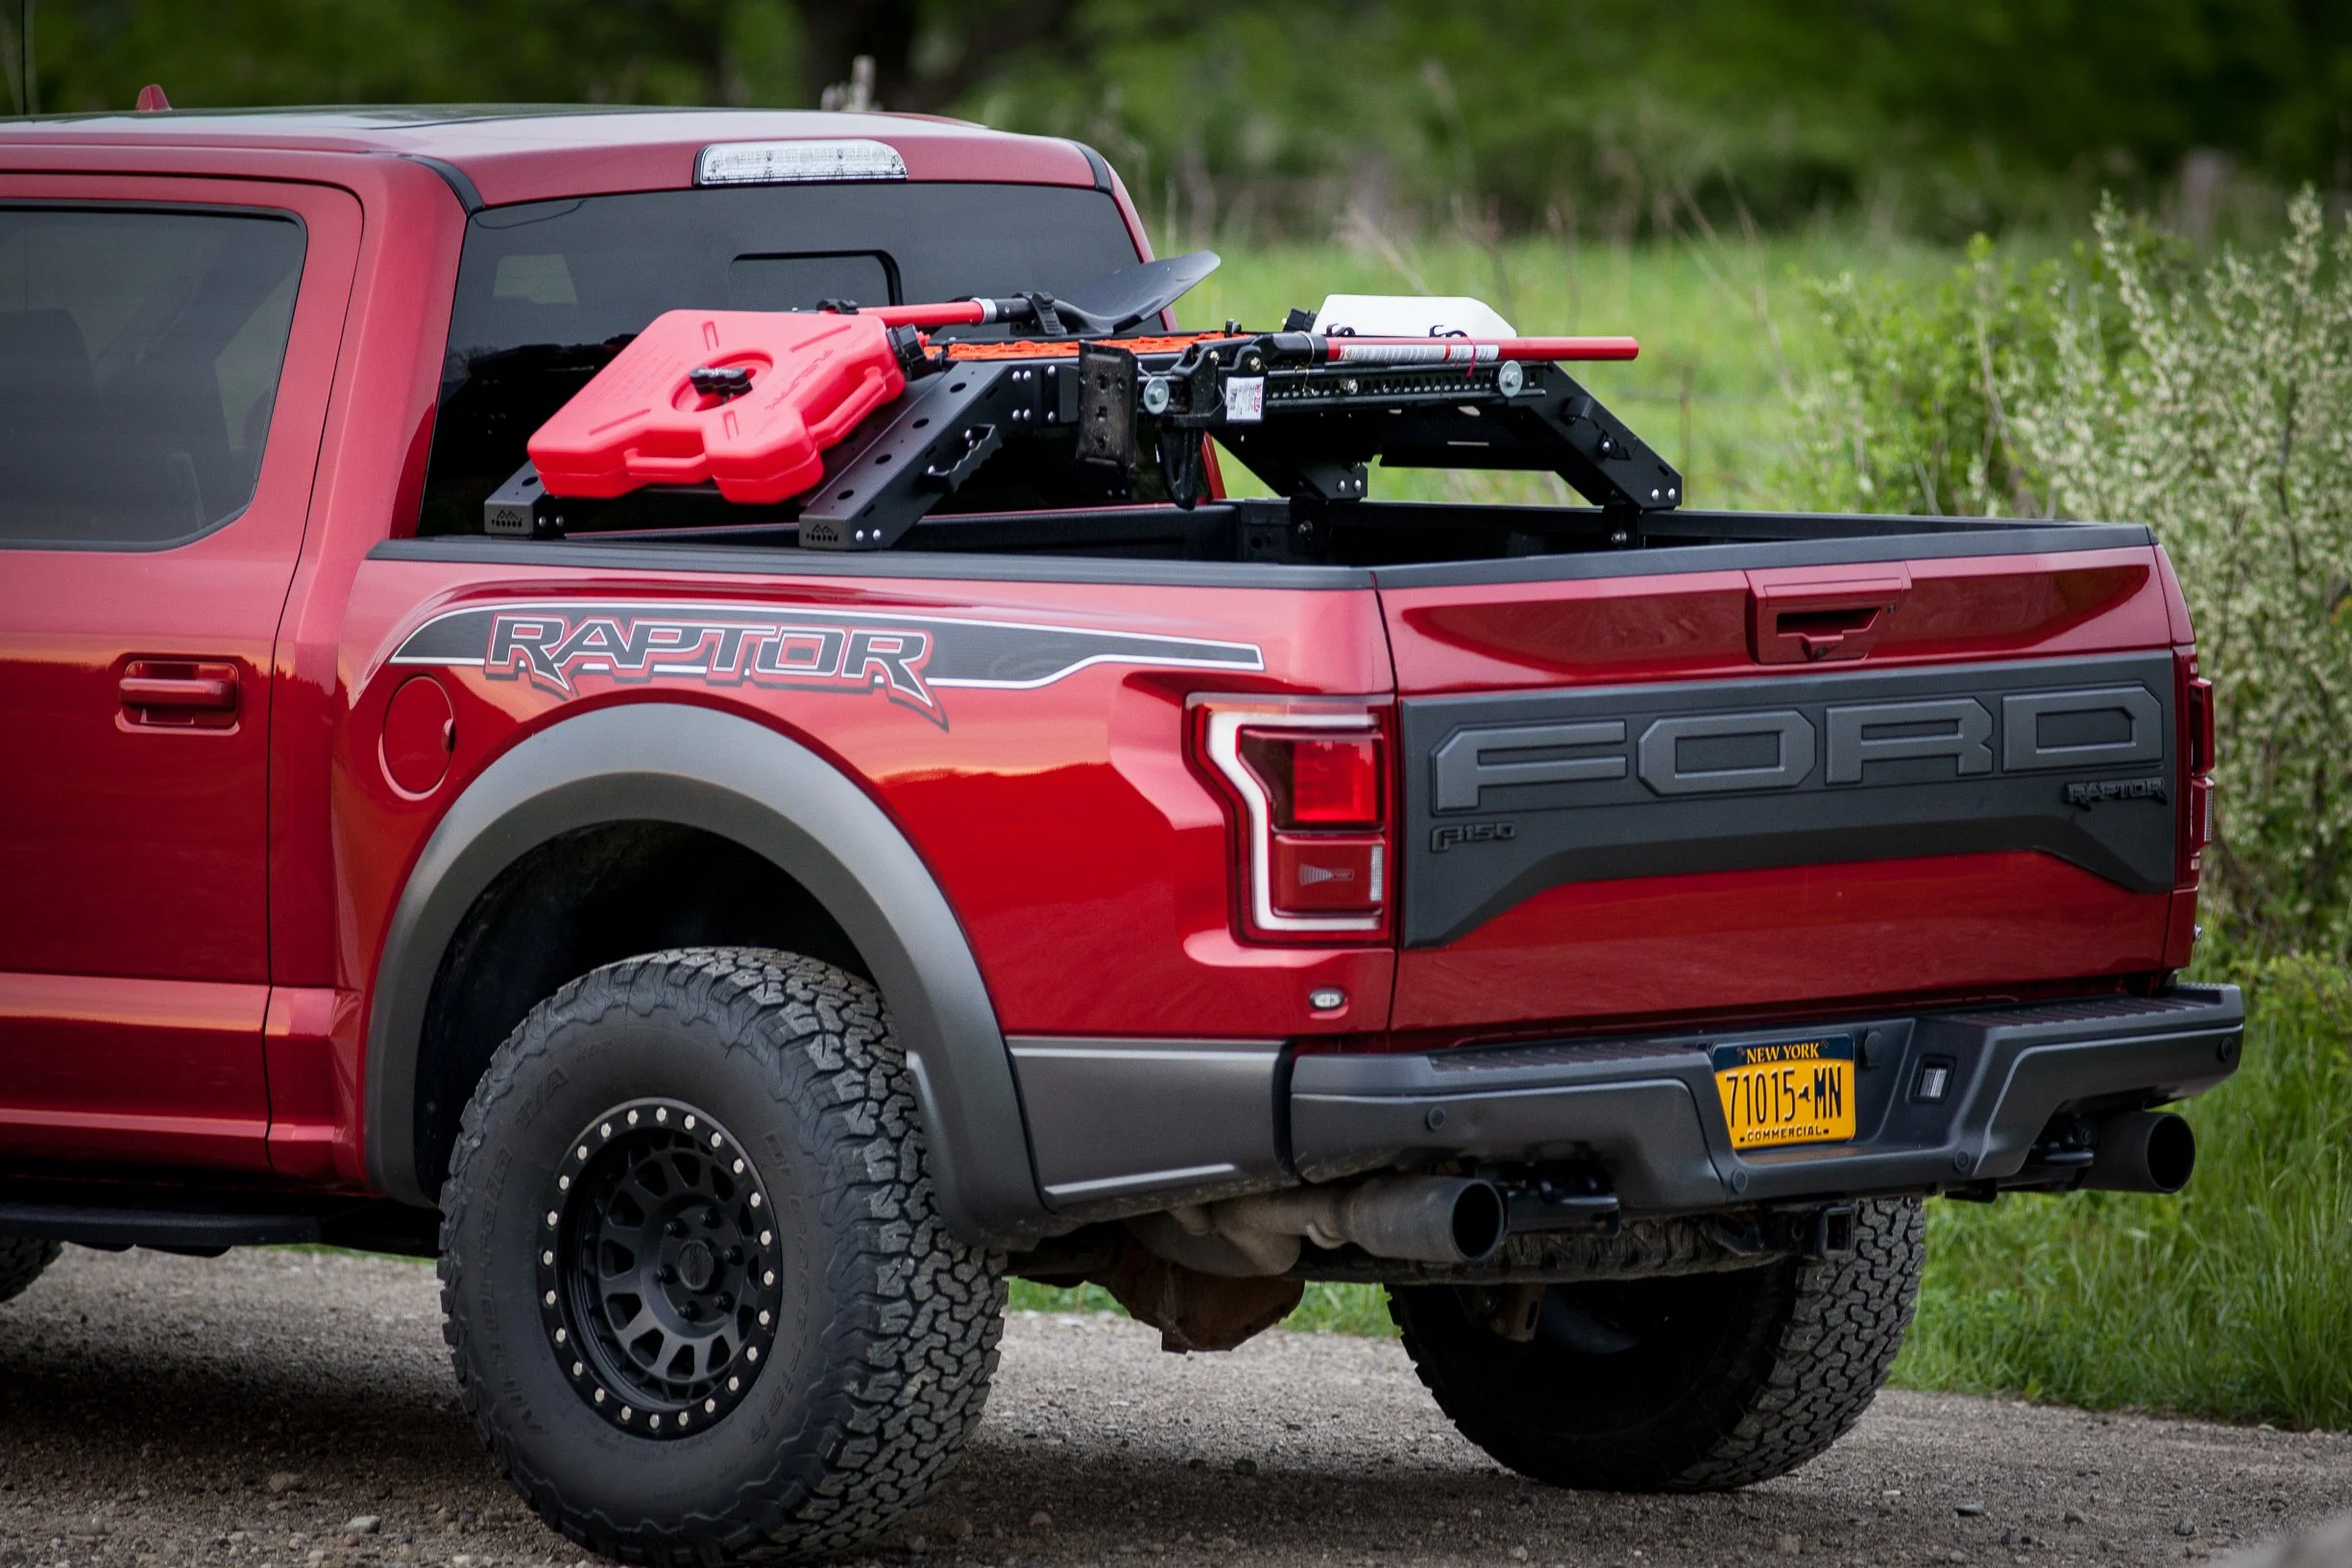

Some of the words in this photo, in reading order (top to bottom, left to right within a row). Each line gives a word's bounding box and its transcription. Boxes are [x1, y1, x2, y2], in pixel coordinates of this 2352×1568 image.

[486, 614, 943, 722] RAPTOR
[1433, 682, 2164, 814] FORD
[2063, 777, 2168, 811] RAPTOR
[1431, 823, 1515, 853] F150
[1746, 1045, 1780, 1064] NEW
[1782, 1042, 1819, 1061] YORK
[1726, 1068, 1795, 1127] 71015
[1814, 1063, 1841, 1120] MN
[1746, 1124, 1822, 1142] COMMERCIAL
